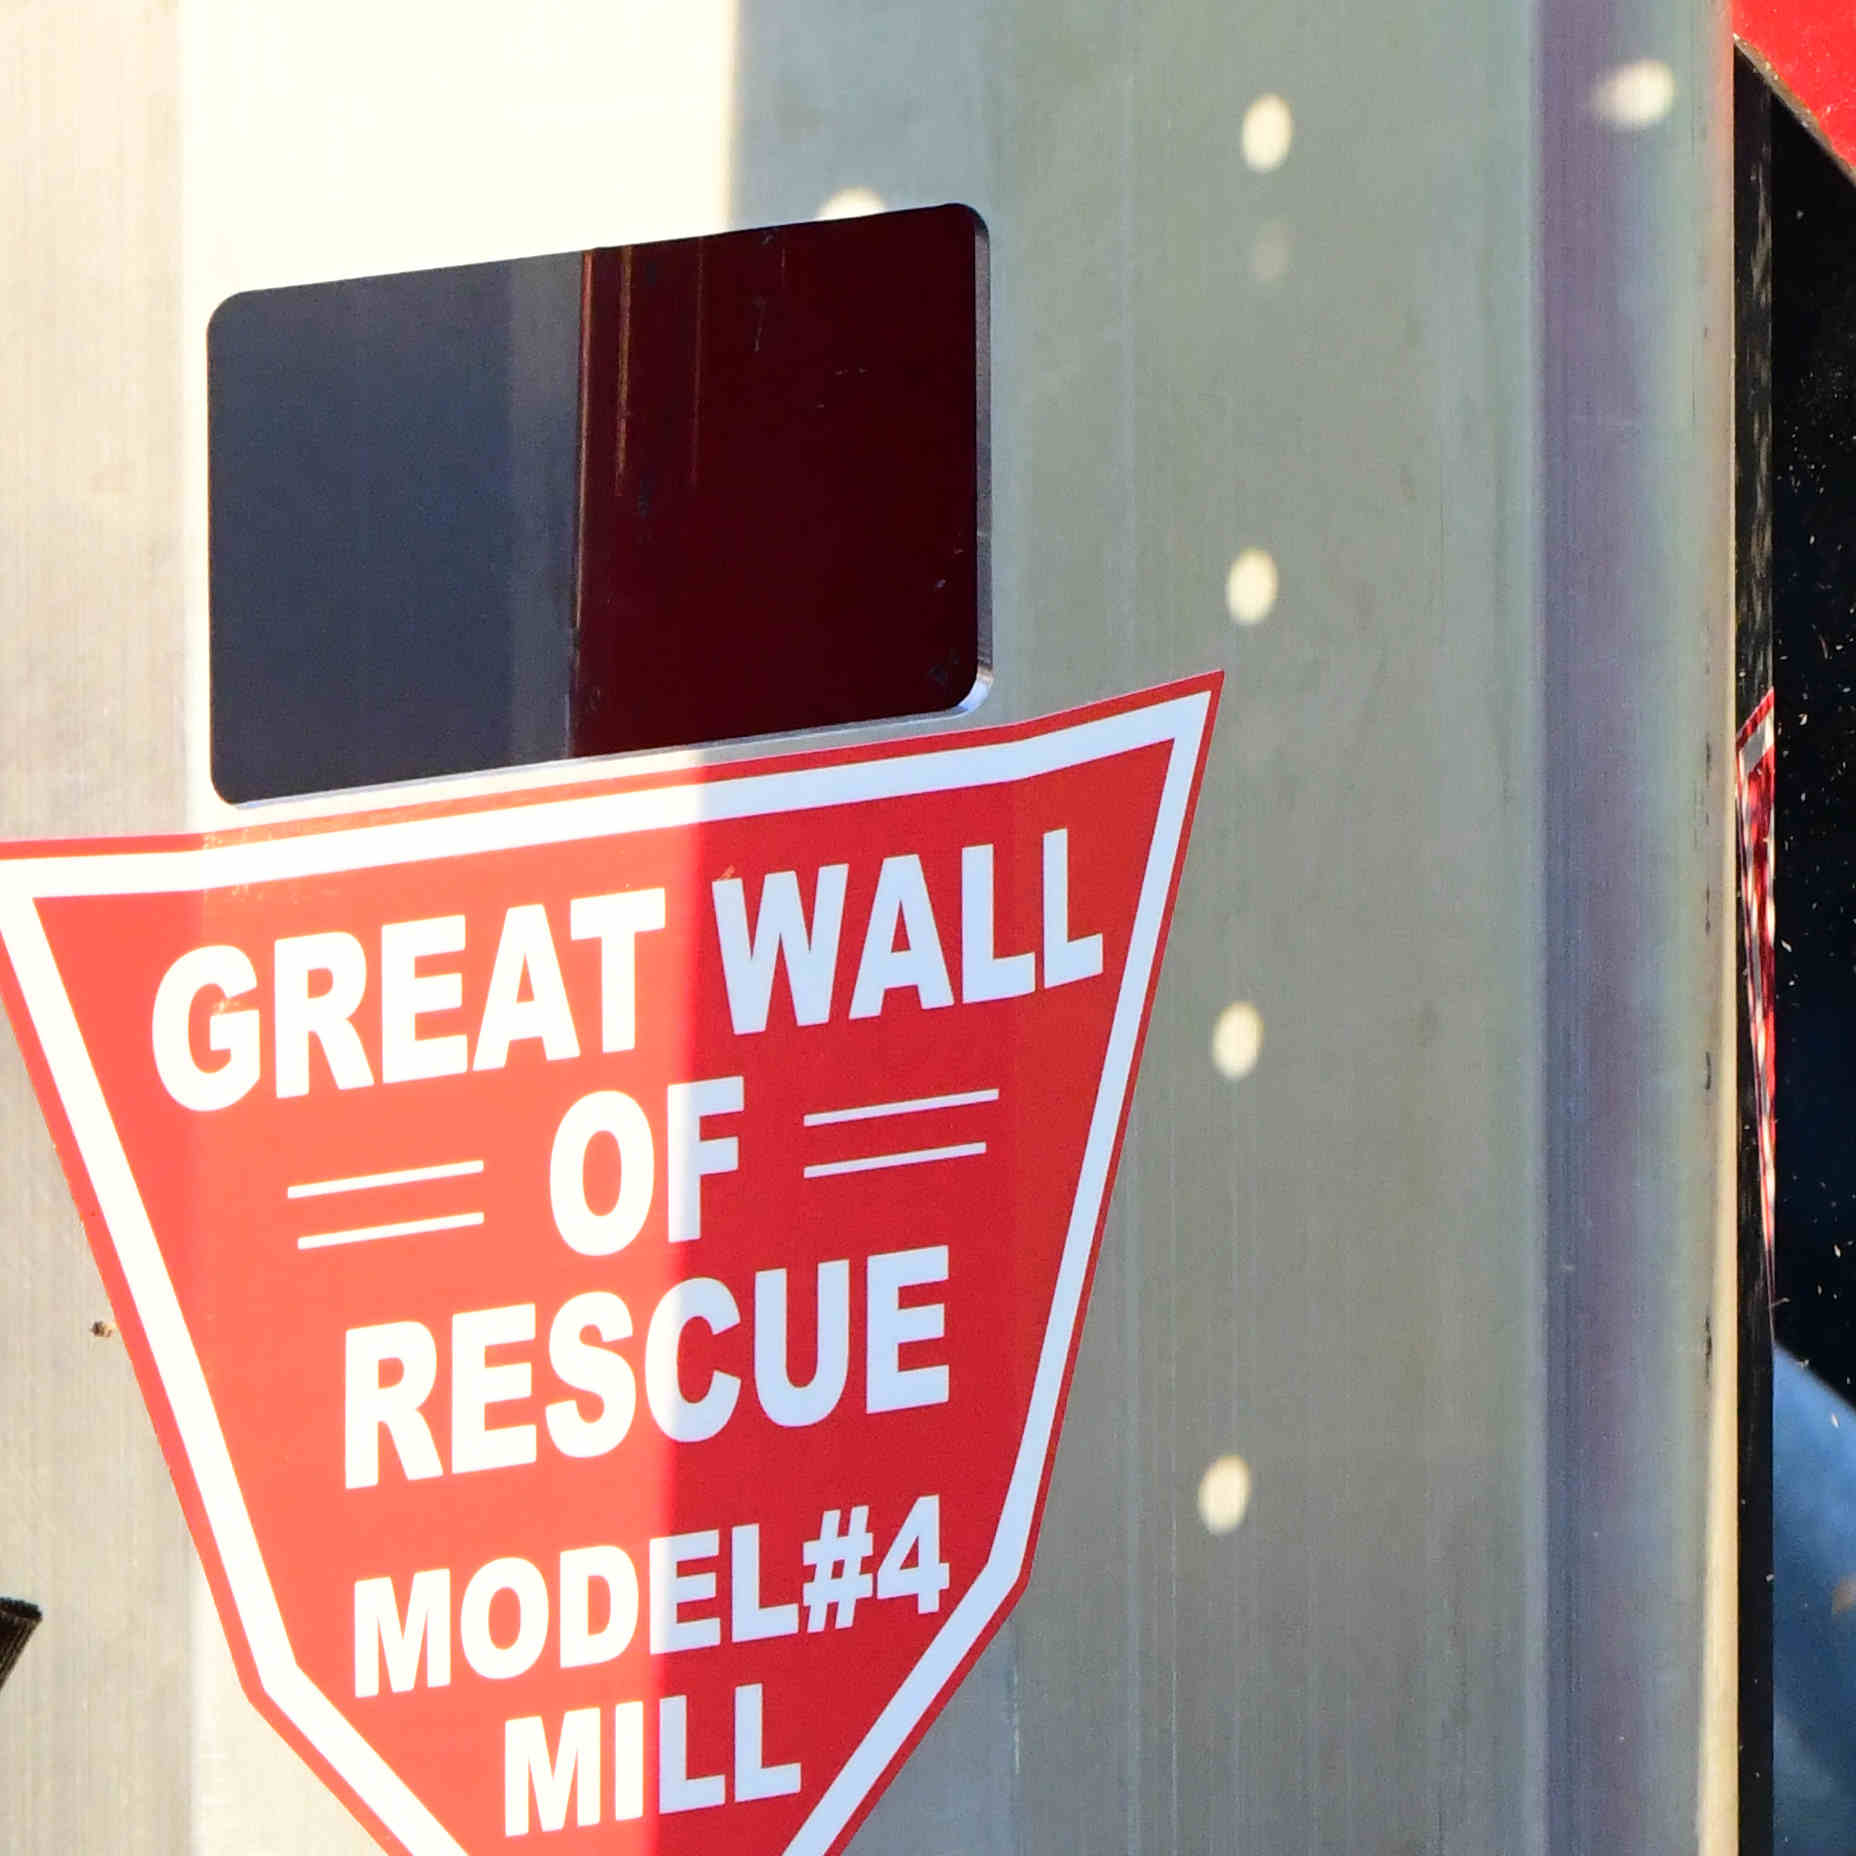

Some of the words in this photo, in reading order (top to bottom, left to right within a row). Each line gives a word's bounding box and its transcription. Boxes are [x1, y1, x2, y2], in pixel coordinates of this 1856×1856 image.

[151, 886, 667, 1114] GREAT
[712, 828, 1106, 1036] WALL
[549, 1075, 746, 1259] OF
[344, 1244, 951, 1490] RESCUE
[352, 1494, 951, 1699] MODEL#4
[502, 1683, 803, 1839] MILL
